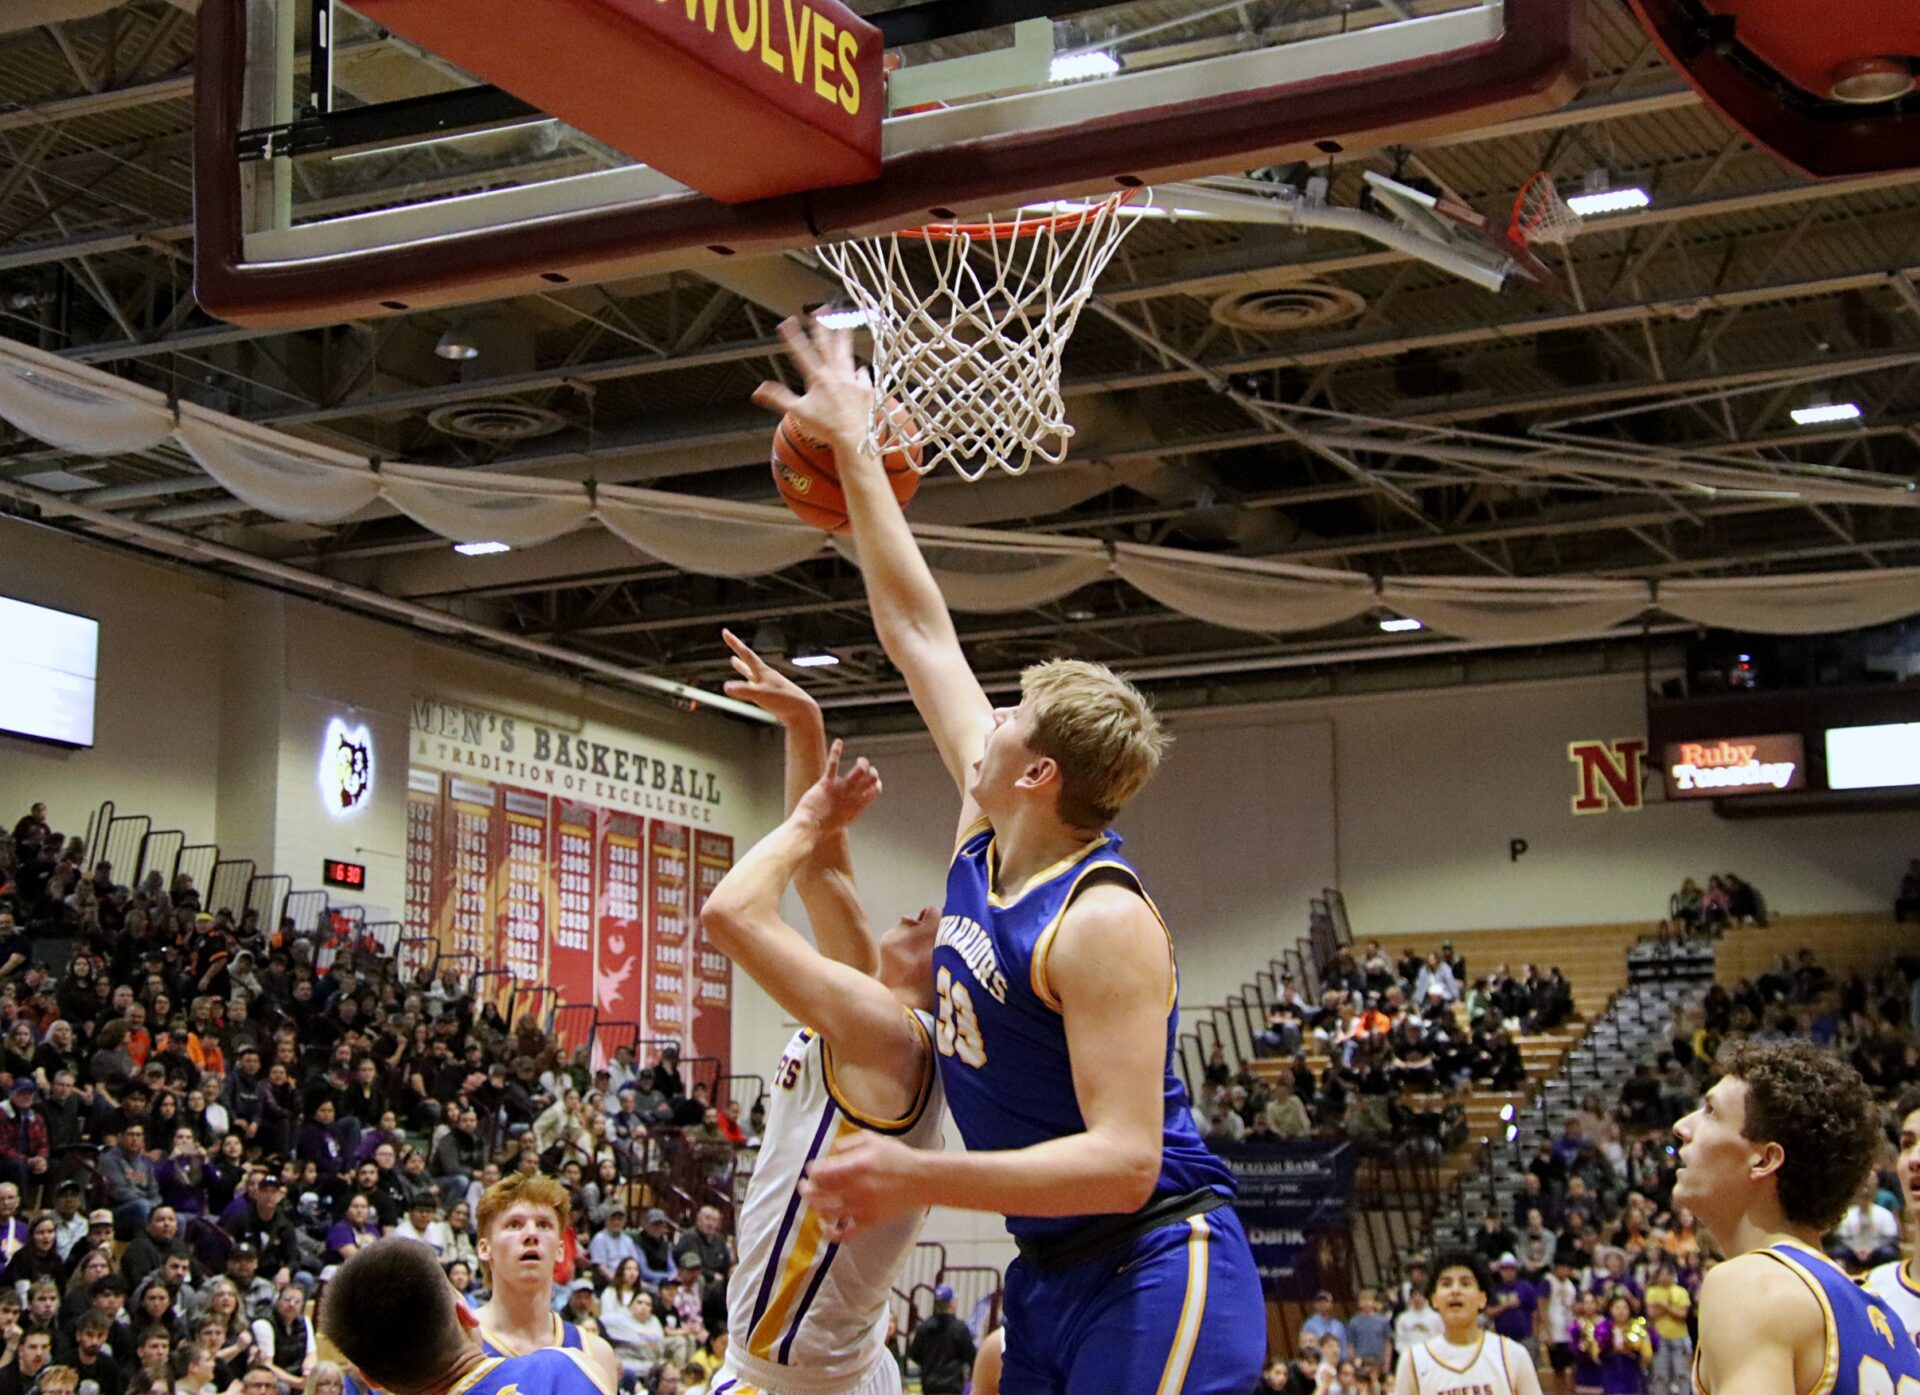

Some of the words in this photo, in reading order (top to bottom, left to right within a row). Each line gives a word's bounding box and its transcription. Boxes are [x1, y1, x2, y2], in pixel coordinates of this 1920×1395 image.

[409, 700, 515, 753] MEN'S
[533, 726, 721, 805] BASKETBALL
[1680, 741, 1757, 768] Ruby
[418, 739, 427, 755] A
[438, 743, 554, 785] TRADITION
[564, 775, 586, 793] OF
[596, 782, 711, 823] EXCELLENCE
[1568, 739, 1648, 814] N
[1672, 759, 1795, 789] Tuesday
[408, 801, 433, 822] 907
[408, 821, 433, 843] 908
[408, 842, 432, 863] 909
[407, 862, 431, 883] 910
[406, 882, 430, 904] 917
[405, 903, 429, 924] 924
[506, 939, 538, 962] 2021
[559, 928, 589, 951] 2021
[1437, 1384, 1494, 1395] GERS
